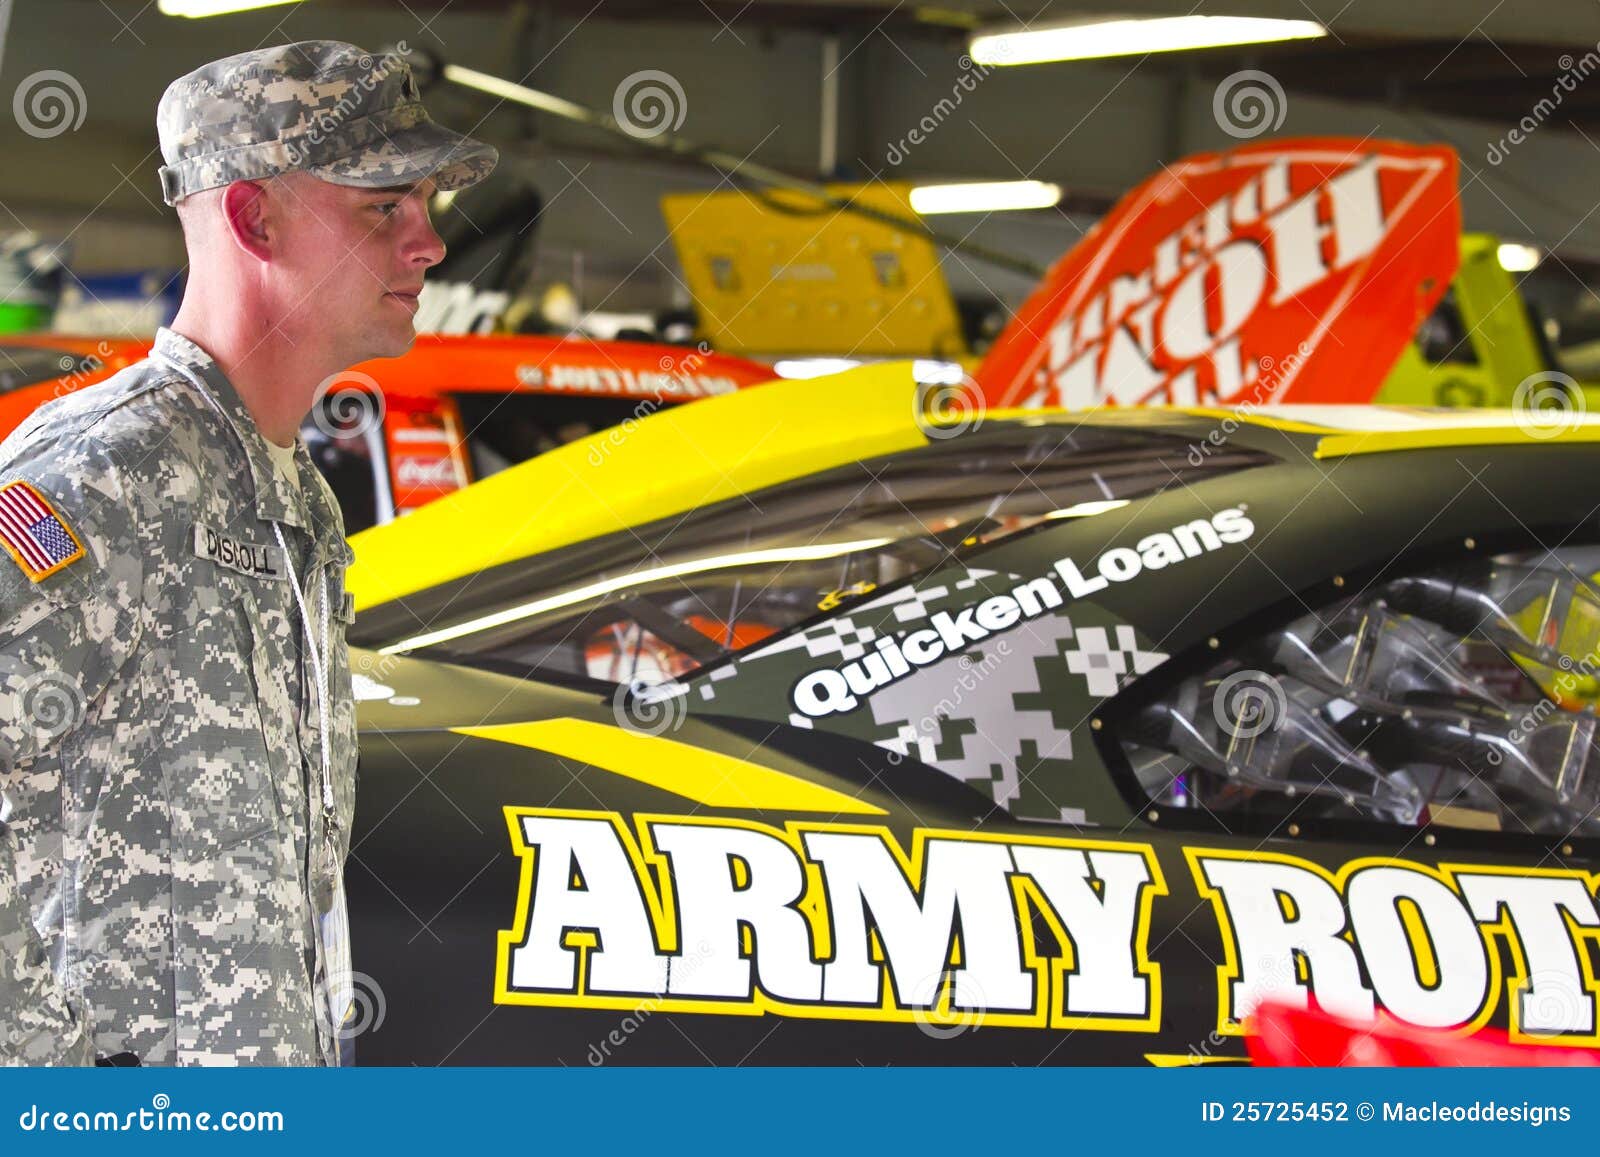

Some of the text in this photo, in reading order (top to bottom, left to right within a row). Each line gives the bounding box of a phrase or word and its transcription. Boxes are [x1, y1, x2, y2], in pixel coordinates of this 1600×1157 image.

[1022, 157, 1386, 411] HOM
[792, 505, 1256, 718] Quicken Loans
[501, 809, 1600, 1042] ARMY ROT
